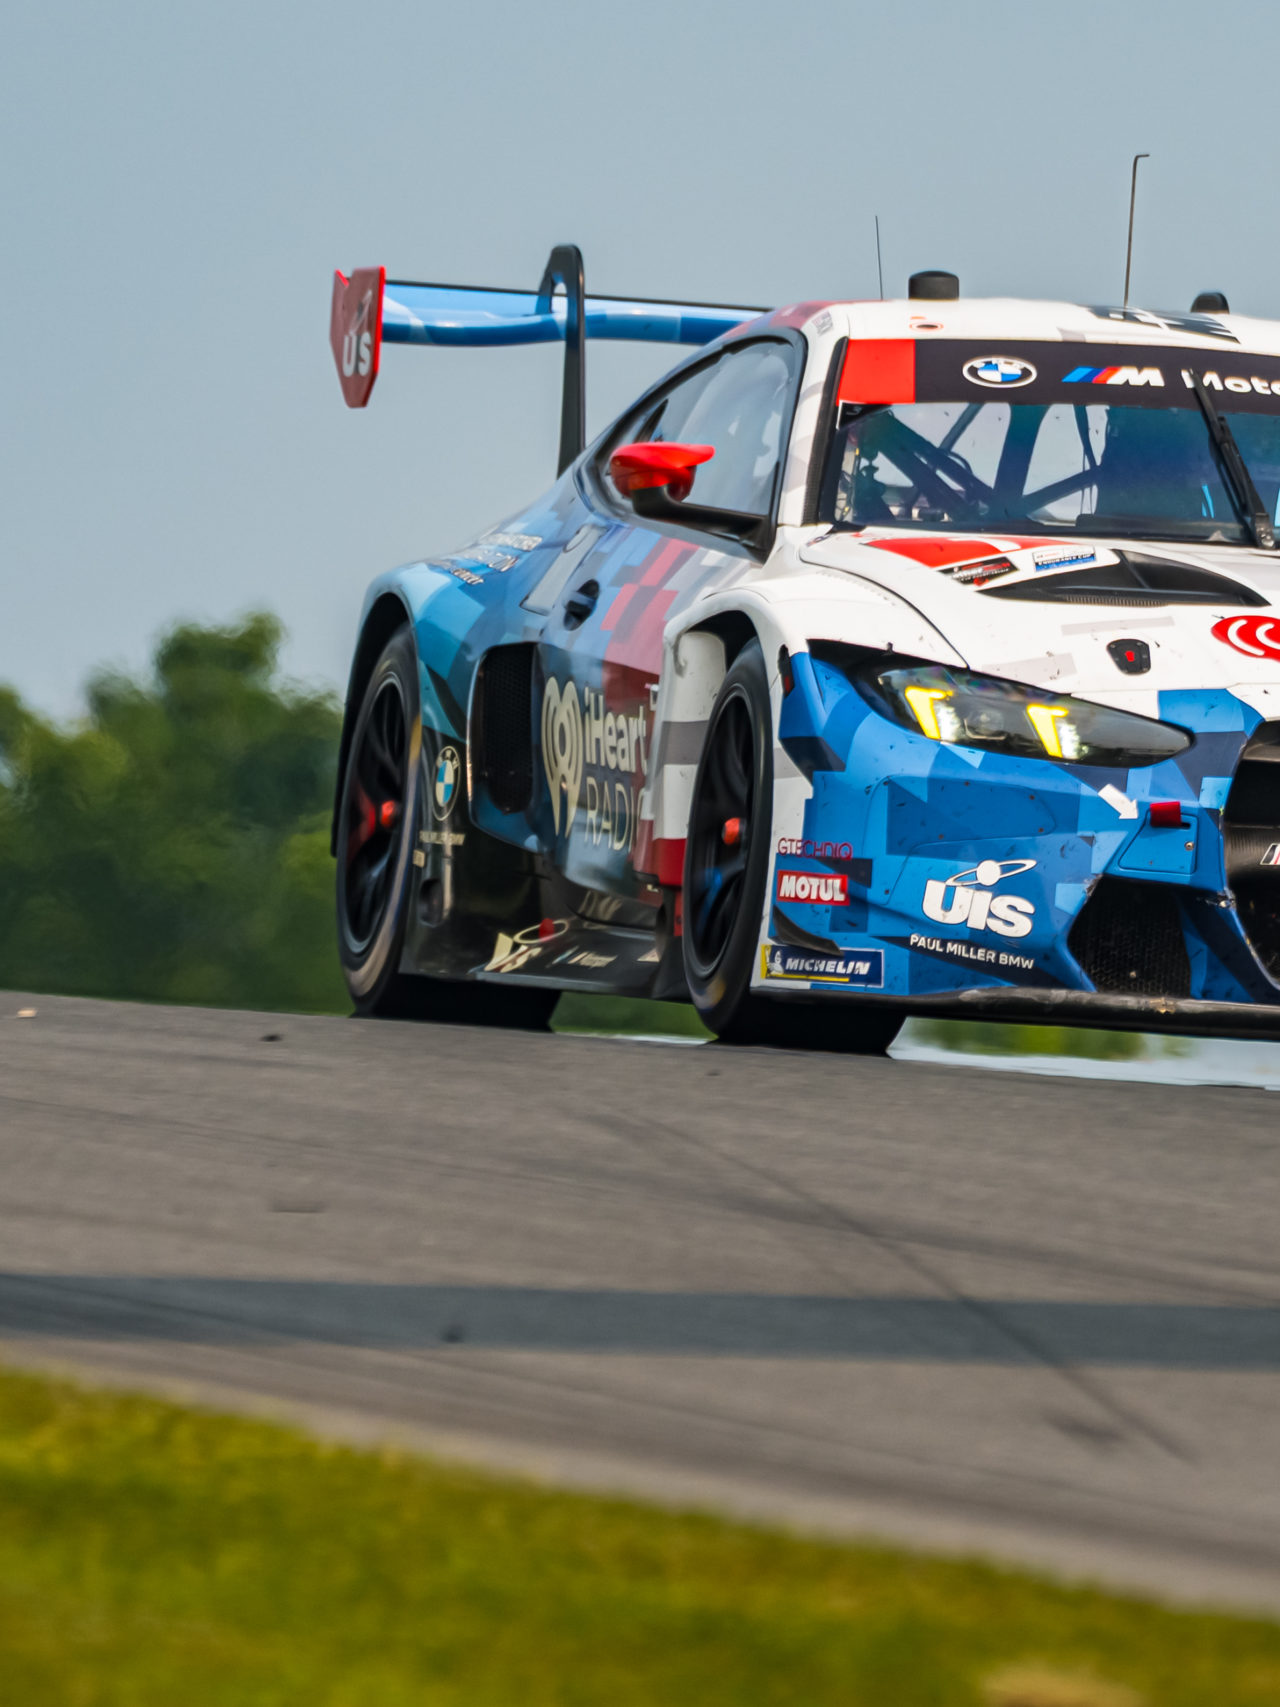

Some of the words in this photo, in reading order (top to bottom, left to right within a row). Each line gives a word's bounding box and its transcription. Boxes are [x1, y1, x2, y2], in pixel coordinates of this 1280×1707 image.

[584, 686, 649, 777] iHeart
[778, 838, 853, 861] GTECHNIQ
[780, 875, 846, 902] MOTUL
[910, 933, 944, 952] PAUL
[946, 942, 996, 963] MILLER
[998, 953, 1034, 970] BMW
[786, 957, 871, 975] MICHELIN
